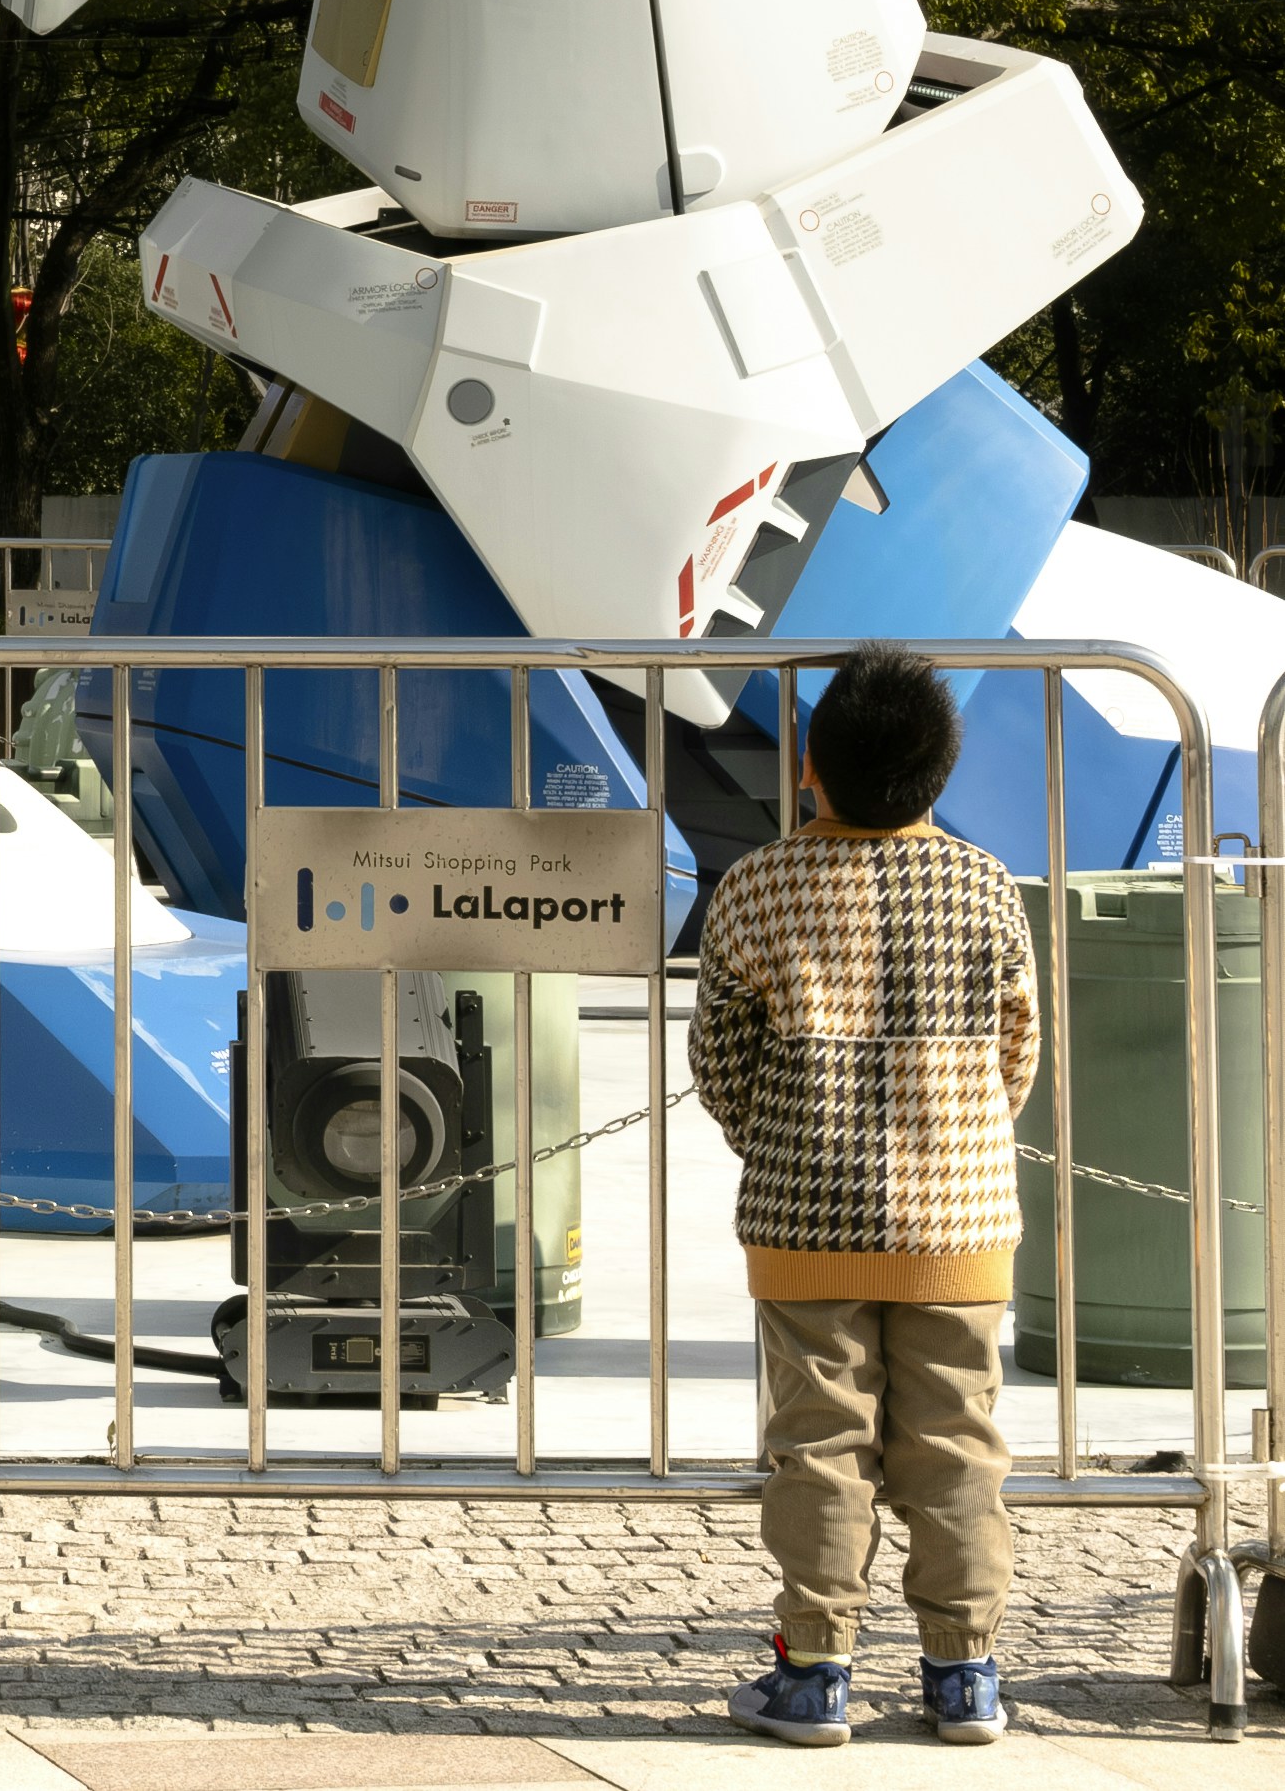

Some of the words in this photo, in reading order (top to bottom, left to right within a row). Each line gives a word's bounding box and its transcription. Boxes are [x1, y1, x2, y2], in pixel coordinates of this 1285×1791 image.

[472, 205, 508, 213] DANGER
[825, 209, 862, 233] CAUTION
[350, 284, 388, 296] ARMOR
[696, 523, 725, 568] WARNING
[556, 764, 599, 774] CAUTION
[353, 850, 411, 869] Mitsui
[424, 852, 516, 876] Shopping
[531, 854, 572, 873] Park
[433, 885, 626, 929] LaLaport
